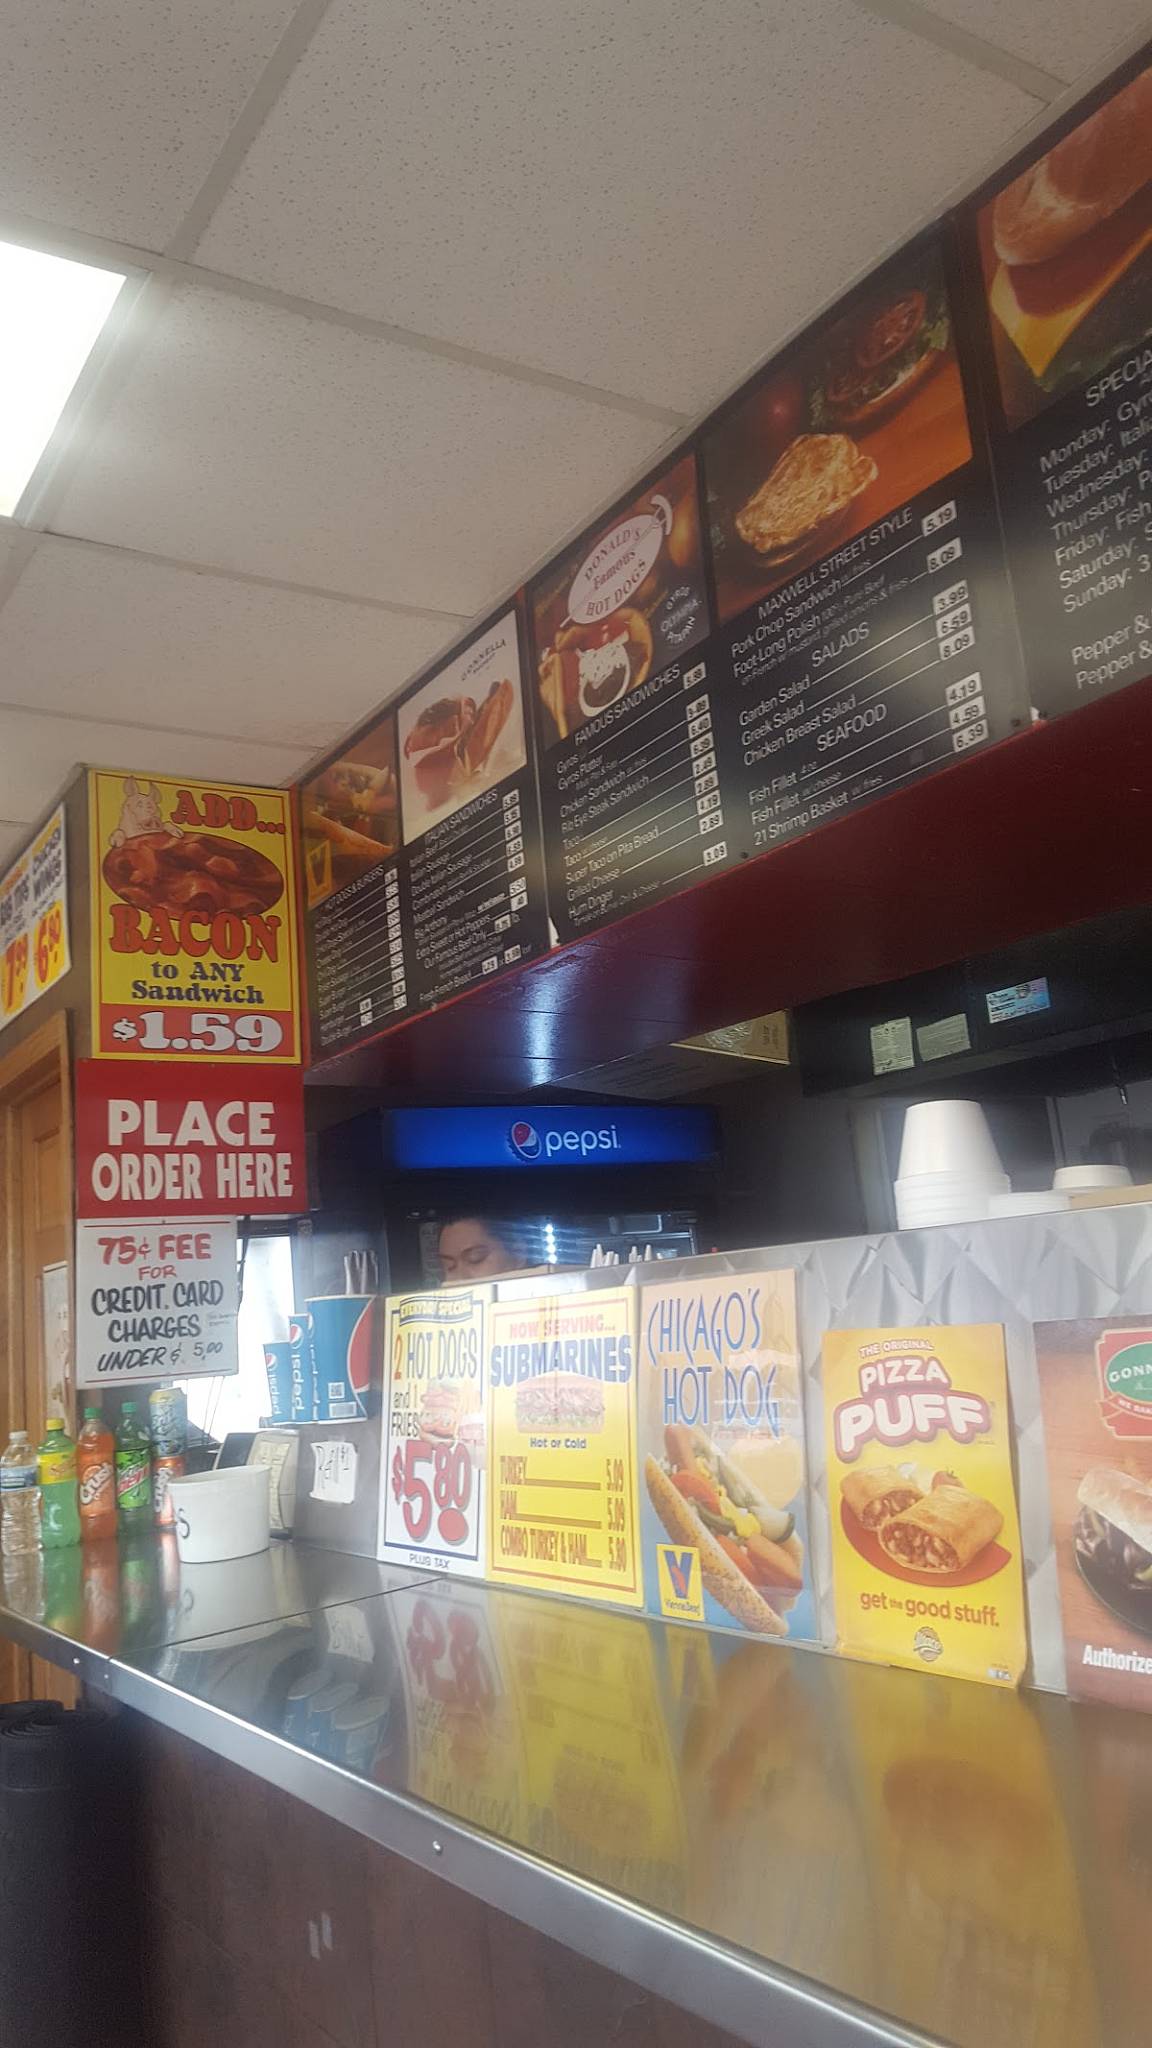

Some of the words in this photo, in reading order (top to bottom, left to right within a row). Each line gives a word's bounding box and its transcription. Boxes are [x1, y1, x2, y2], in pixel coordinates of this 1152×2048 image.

[927, 507, 953, 533] 5.19
[758, 573, 818, 621] MAXWELL
[819, 536, 868, 579] STREET
[870, 506, 913, 547] STYLE
[586, 597, 610, 616] HOT
[614, 558, 646, 602] DOGS
[731, 633, 755, 658] Pork
[755, 614, 785, 642] Chop
[785, 578, 842, 623] Sandwich
[733, 638, 787, 678] Foot-Long
[786, 613, 822, 644] Polish
[811, 622, 871, 668] SALADS
[1071, 625, 1131, 665] Pepper
[1134, 615, 1151, 634] &
[1075, 650, 1136, 689] Pepper
[574, 708, 614, 746] FAMOUS
[614, 663, 680, 720] SANDWICHES
[738, 695, 778, 727] Garden
[778, 673, 812, 702] Salad
[949, 678, 978, 701] 4.19
[741, 720, 773, 746] Greek
[774, 700, 805, 728] Salad
[743, 734, 787, 767] Chicken
[787, 714, 823, 744] Breast
[822, 693, 857, 724] Salad
[816, 703, 888, 753] SEAFOOD
[951, 703, 980, 725] 4.59
[955, 723, 985, 749] 6.39
[749, 783, 771, 805] Fish
[771, 770, 798, 797] Fillet
[170, 789, 287, 835] ADD...
[752, 802, 775, 826] Fish
[774, 791, 800, 818] Fillet
[768, 810, 809, 841] Shrimp
[809, 791, 849, 820] Basket
[633, 825, 660, 849] Bread
[109, 902, 282, 963] BACON
[151, 960, 179, 982] to
[190, 961, 246, 983] ANY
[131, 979, 266, 1004] Sandwich
[112, 1011, 283, 1053] $1.59
[107, 1099, 276, 1147] PLACE
[545, 1124, 619, 1157] pepsi
[91, 1153, 204, 1201] ORDER
[216, 1152, 294, 1200] HERE
[97, 1237, 152, 1266] 75¢
[158, 1233, 213, 1261] FEE
[138, 1264, 177, 1281] FOR
[172, 1279, 225, 1309] CARD
[108, 1314, 201, 1343] CHARGES
[509, 1320, 538, 1339] NOW
[647, 1287, 761, 1367] CHICAGO'S
[97, 1346, 168, 1374] UNDER
[407, 1331, 433, 1379] HOT
[437, 1327, 477, 1380] DOGS
[490, 1334, 632, 1387] SUBMARINES
[859, 1343, 881, 1358] THE
[882, 1338, 936, 1353] ORIGINAL
[861, 1359, 949, 1391] PIZZA
[663, 1366, 713, 1426] HOT
[724, 1364, 781, 1438] DOG
[391, 1411, 419, 1438] FRIES
[838, 1393, 985, 1454] PUFF
[530, 1437, 548, 1449] Hot
[550, 1439, 562, 1449] or
[564, 1437, 587, 1450] Cold
[409, 1553, 432, 1567] PLUS
[434, 1556, 450, 1570] TAX
[530, 1528, 559, 1562] TURKEY
[860, 1591, 887, 1611] get
[889, 1598, 903, 1609] the
[905, 1597, 951, 1622] good
[954, 1604, 1000, 1628] stuff.
